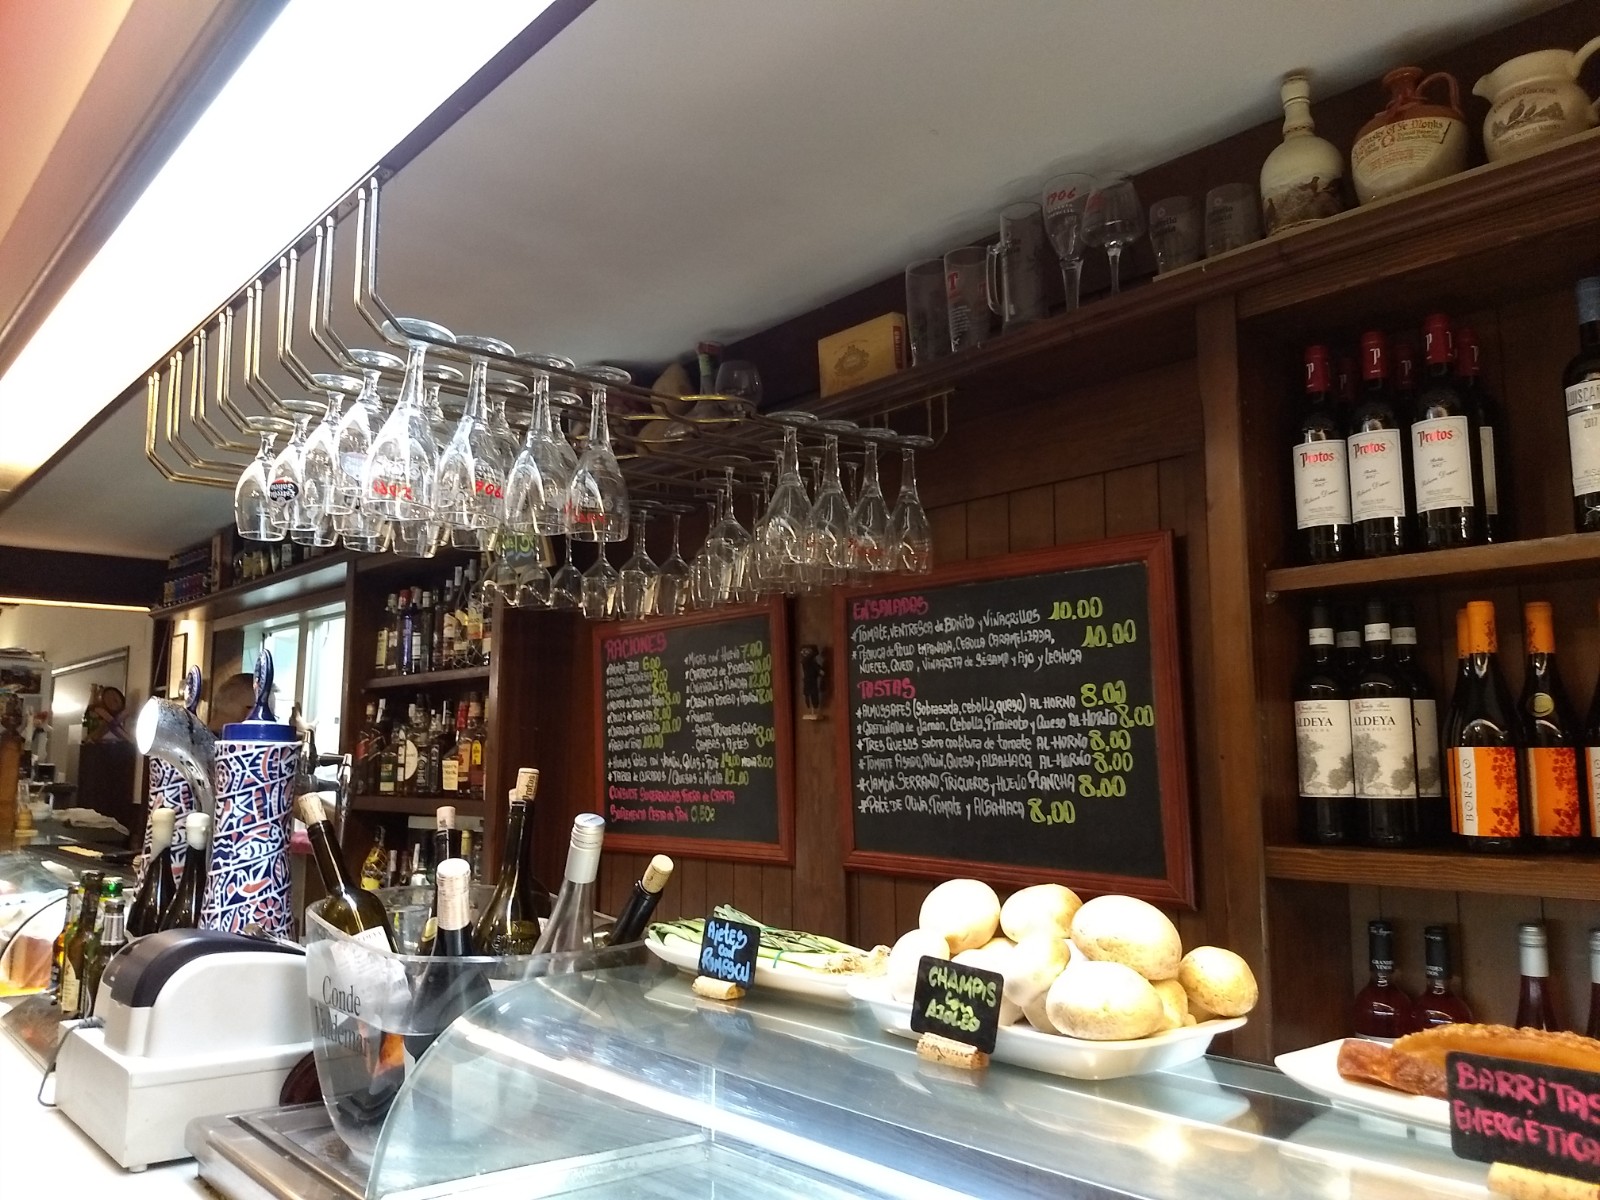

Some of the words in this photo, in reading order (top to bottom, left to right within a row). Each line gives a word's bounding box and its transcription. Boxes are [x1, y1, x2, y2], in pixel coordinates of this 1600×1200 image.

[1417, 429, 1454, 447] Protos
[1300, 451, 1335, 468] Protos
[1352, 442, 1386, 459] Protos
[1048, 596, 1103, 620] 10.00
[1081, 619, 1137, 647] 10.00
[605, 632, 667, 661] RACIONES
[857, 677, 916, 700] TOSTAS
[1030, 697, 1042, 710] AL
[1042, 694, 1076, 709] HORNO
[1080, 680, 1127, 707] 8.00
[1114, 704, 1154, 728] 8.00
[1089, 729, 1132, 752] 8.00
[981, 753, 1032, 770] ALBAHACA
[1092, 752, 1133, 774] 8.00
[1027, 770, 1076, 793] PLANCHA
[1078, 774, 1126, 798] 8.00
[1462, 758, 1474, 822] BORSAO
[973, 797, 1025, 819] ALBAHACA
[322, 976, 361, 1016] Conde
